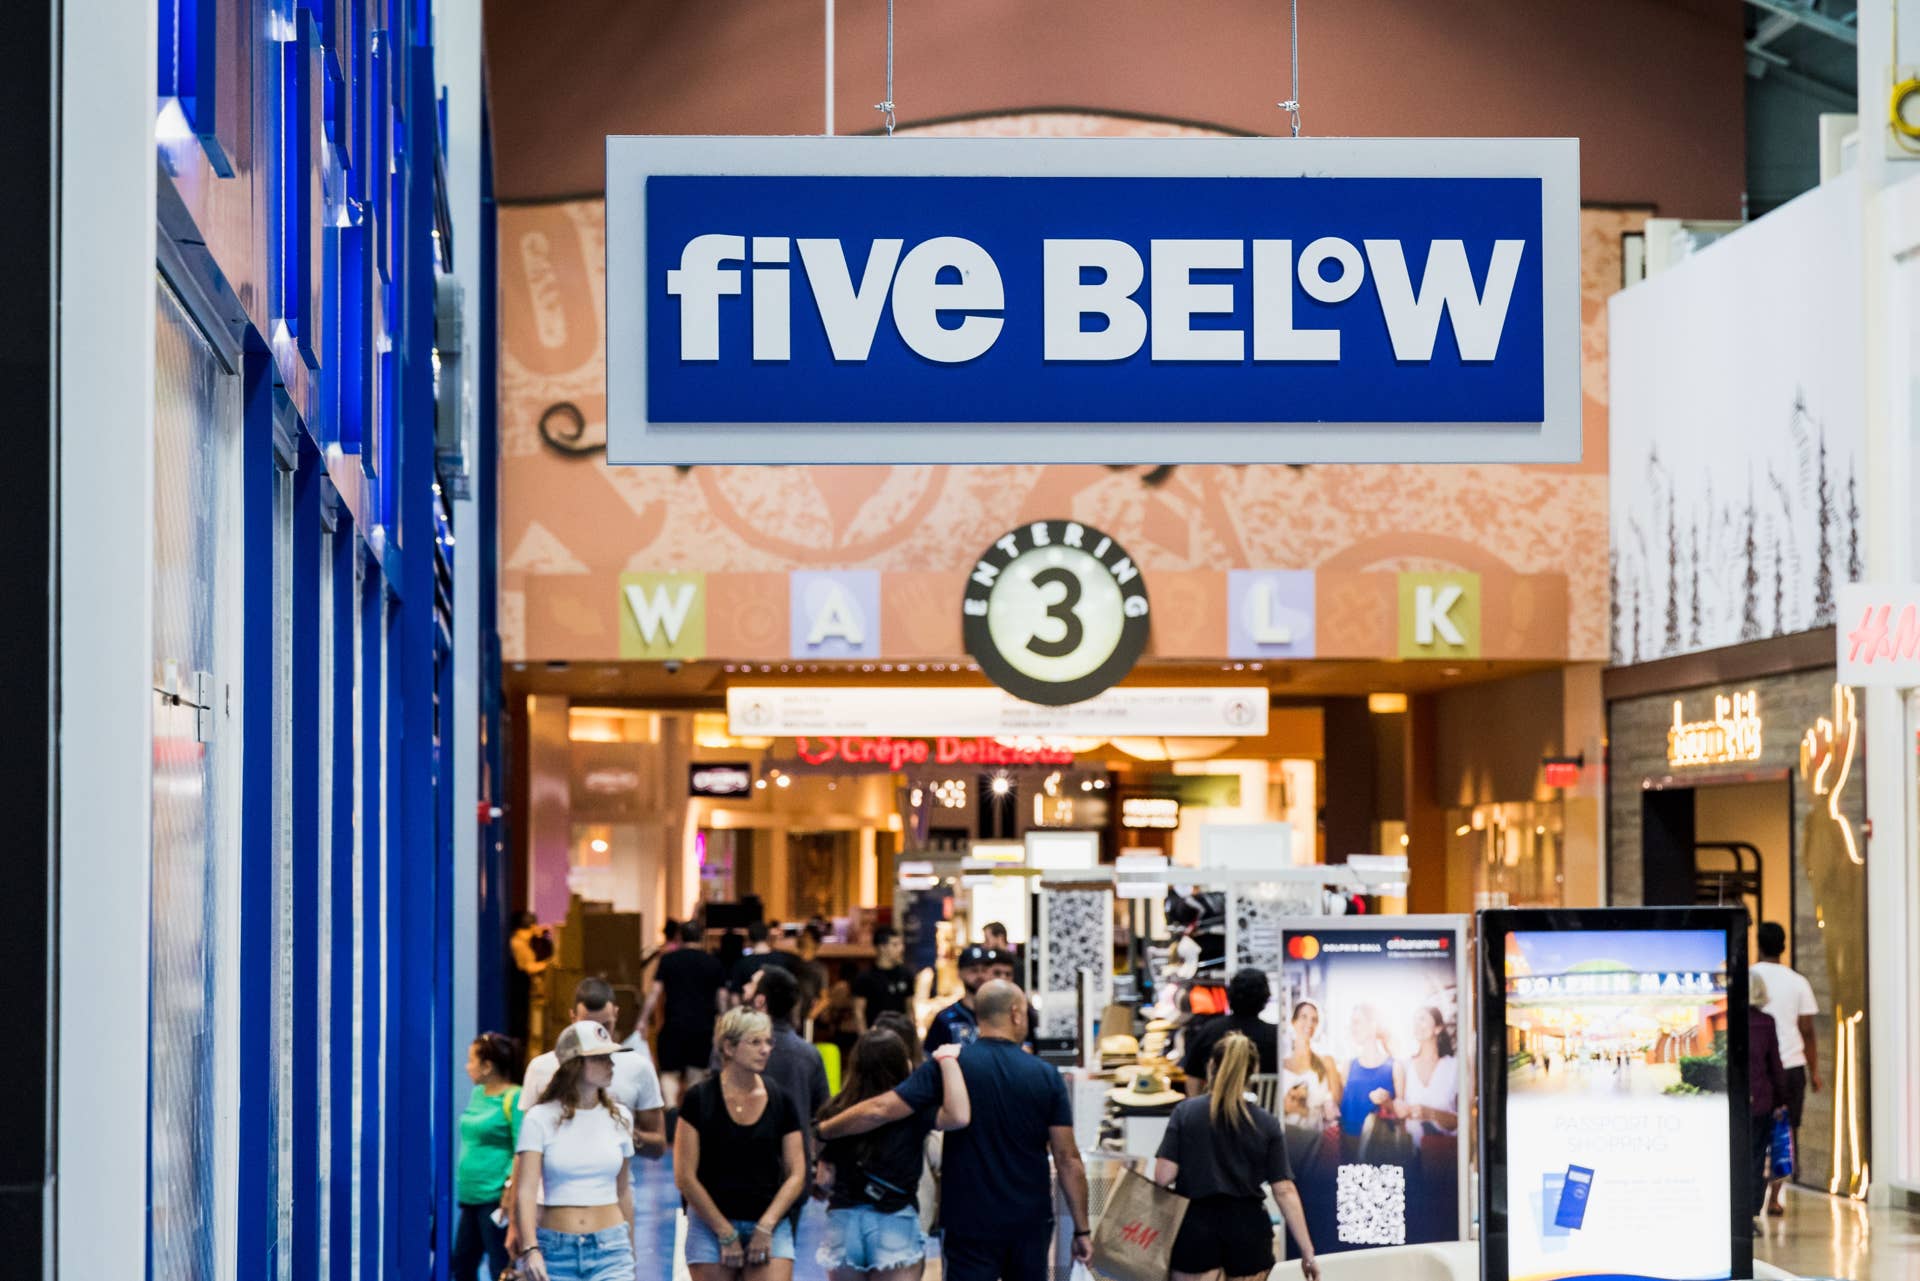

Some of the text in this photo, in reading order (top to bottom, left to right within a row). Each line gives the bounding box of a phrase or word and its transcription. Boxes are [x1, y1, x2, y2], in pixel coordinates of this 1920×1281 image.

[667, 234, 1526, 363] five BELOW
[963, 521, 1149, 618] ENTERING
[1026, 567, 1083, 657] 3
[1656, 1113, 1681, 1132] TO
